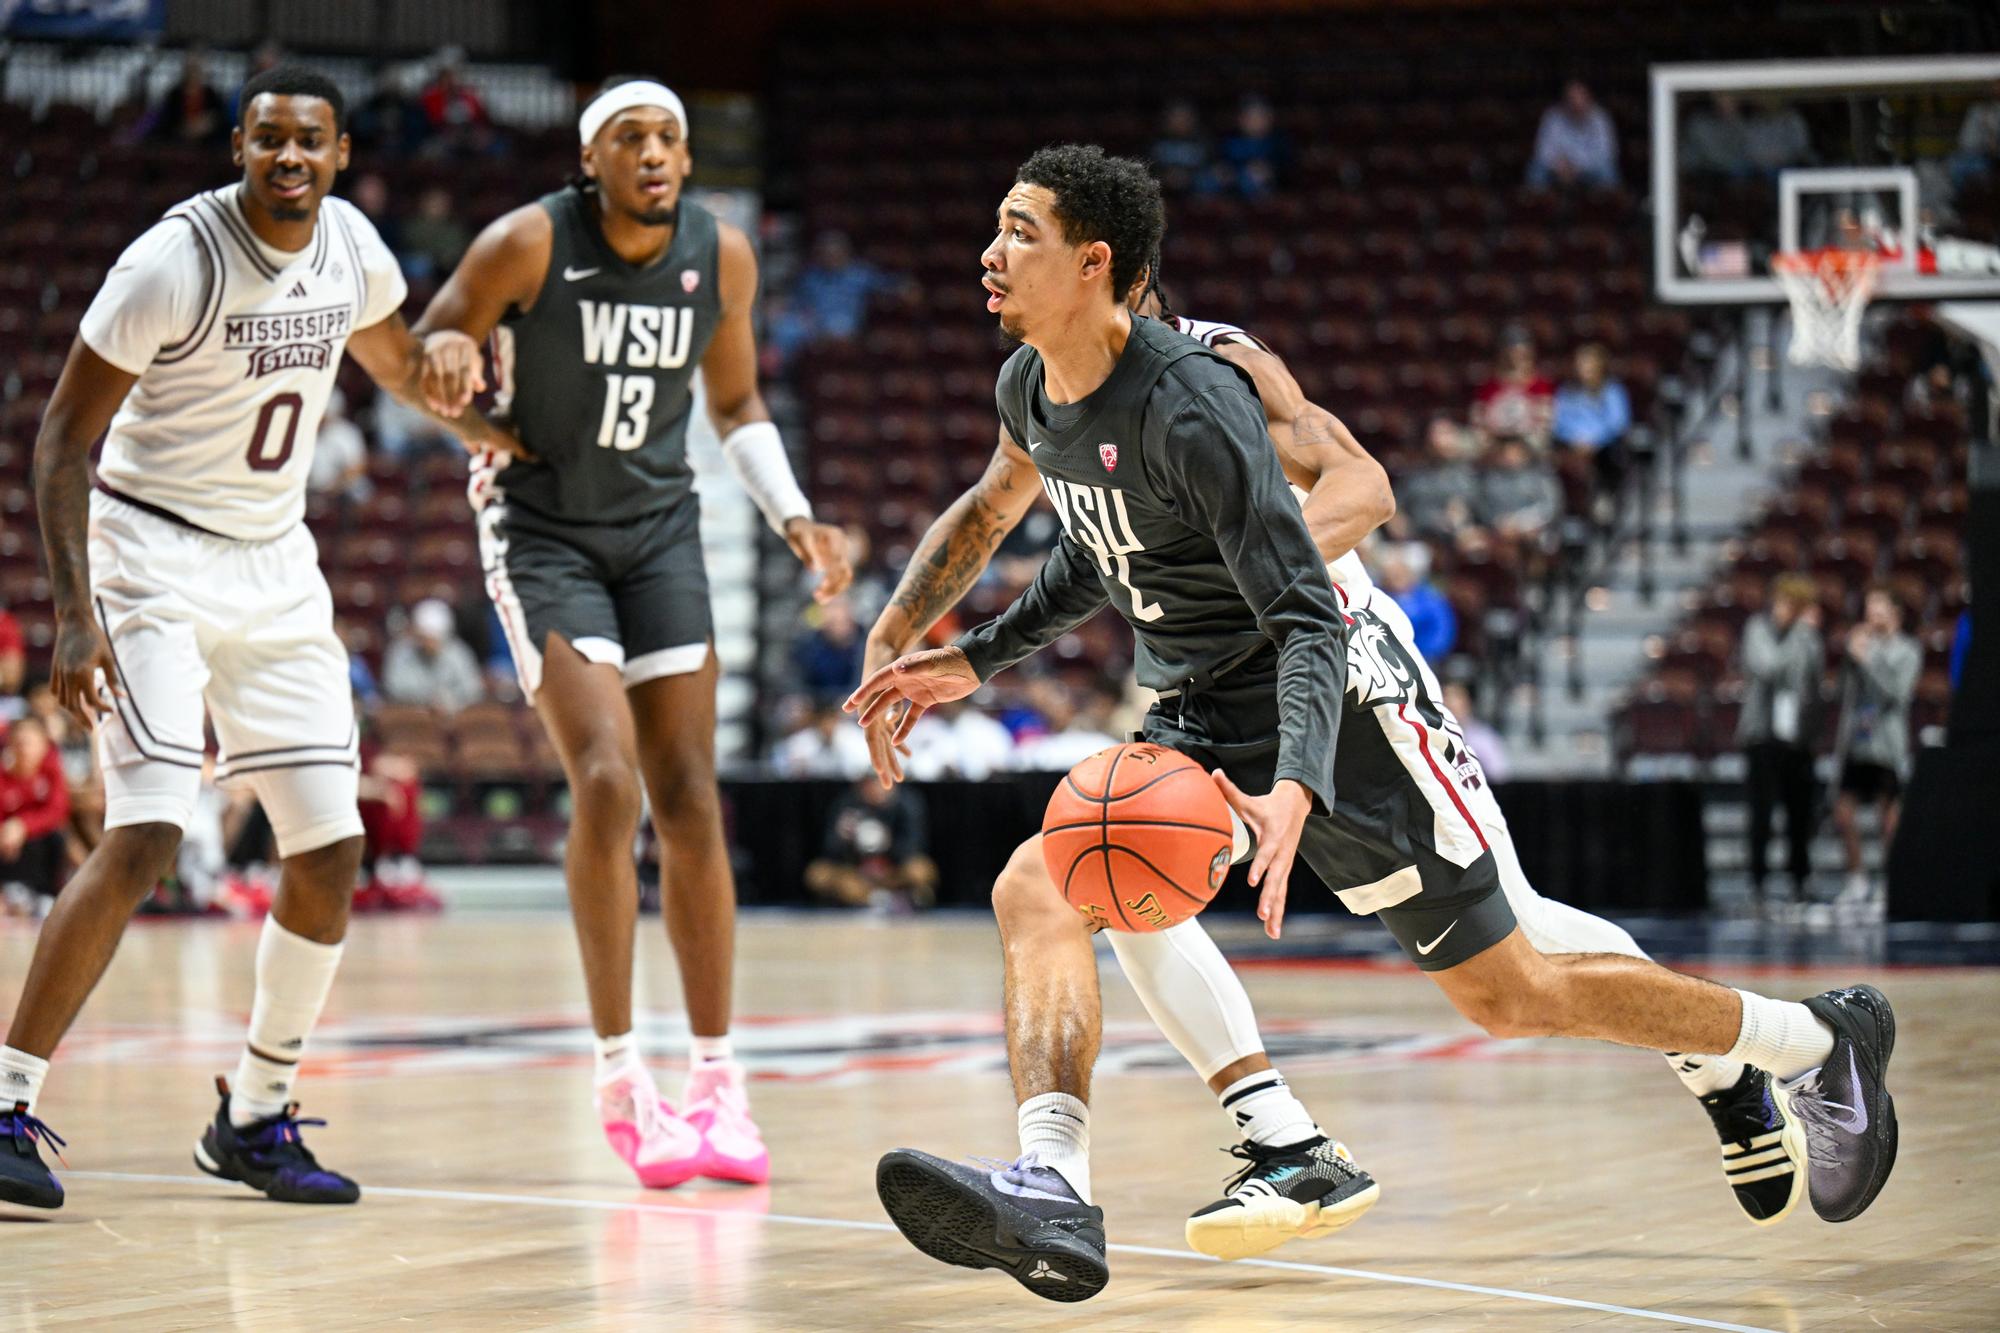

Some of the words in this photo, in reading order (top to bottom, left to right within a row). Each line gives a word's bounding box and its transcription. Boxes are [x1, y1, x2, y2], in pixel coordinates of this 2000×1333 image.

[224, 309, 351, 345] MISSISSIPPI
[262, 347, 322, 371] STATE
[578, 299, 694, 369] WSU
[245, 392, 303, 472] 0
[597, 374, 655, 451] 13
[1039, 473, 1146, 556] WSU
